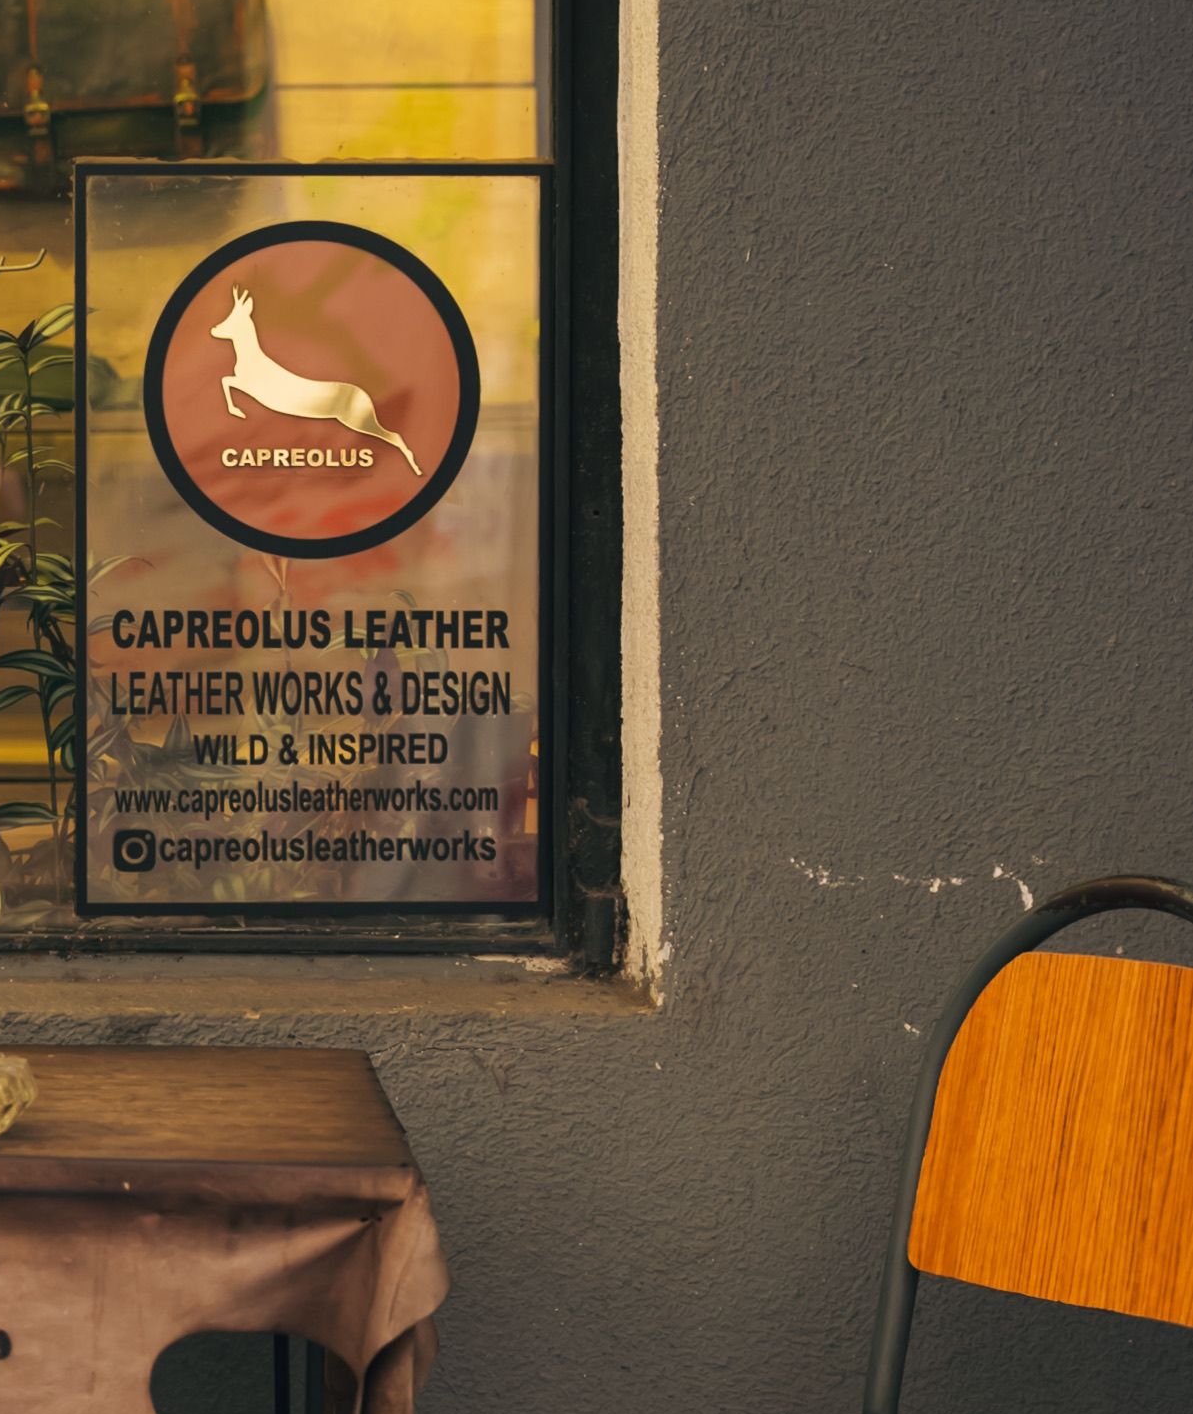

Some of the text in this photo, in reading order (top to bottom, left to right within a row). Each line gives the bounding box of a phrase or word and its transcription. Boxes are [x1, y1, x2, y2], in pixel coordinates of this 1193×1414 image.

[221, 448, 374, 467] CAPREOLUS
[112, 610, 510, 649] CAPREOLUS LEATHER
[111, 671, 511, 716] LEATHER WORKS & DESIGN
[193, 733, 448, 765] WILD & INSPIRED
[114, 780, 499, 821] www.capreolusleatherworks.com
[159, 830, 497, 870] capreolusleatherworks
